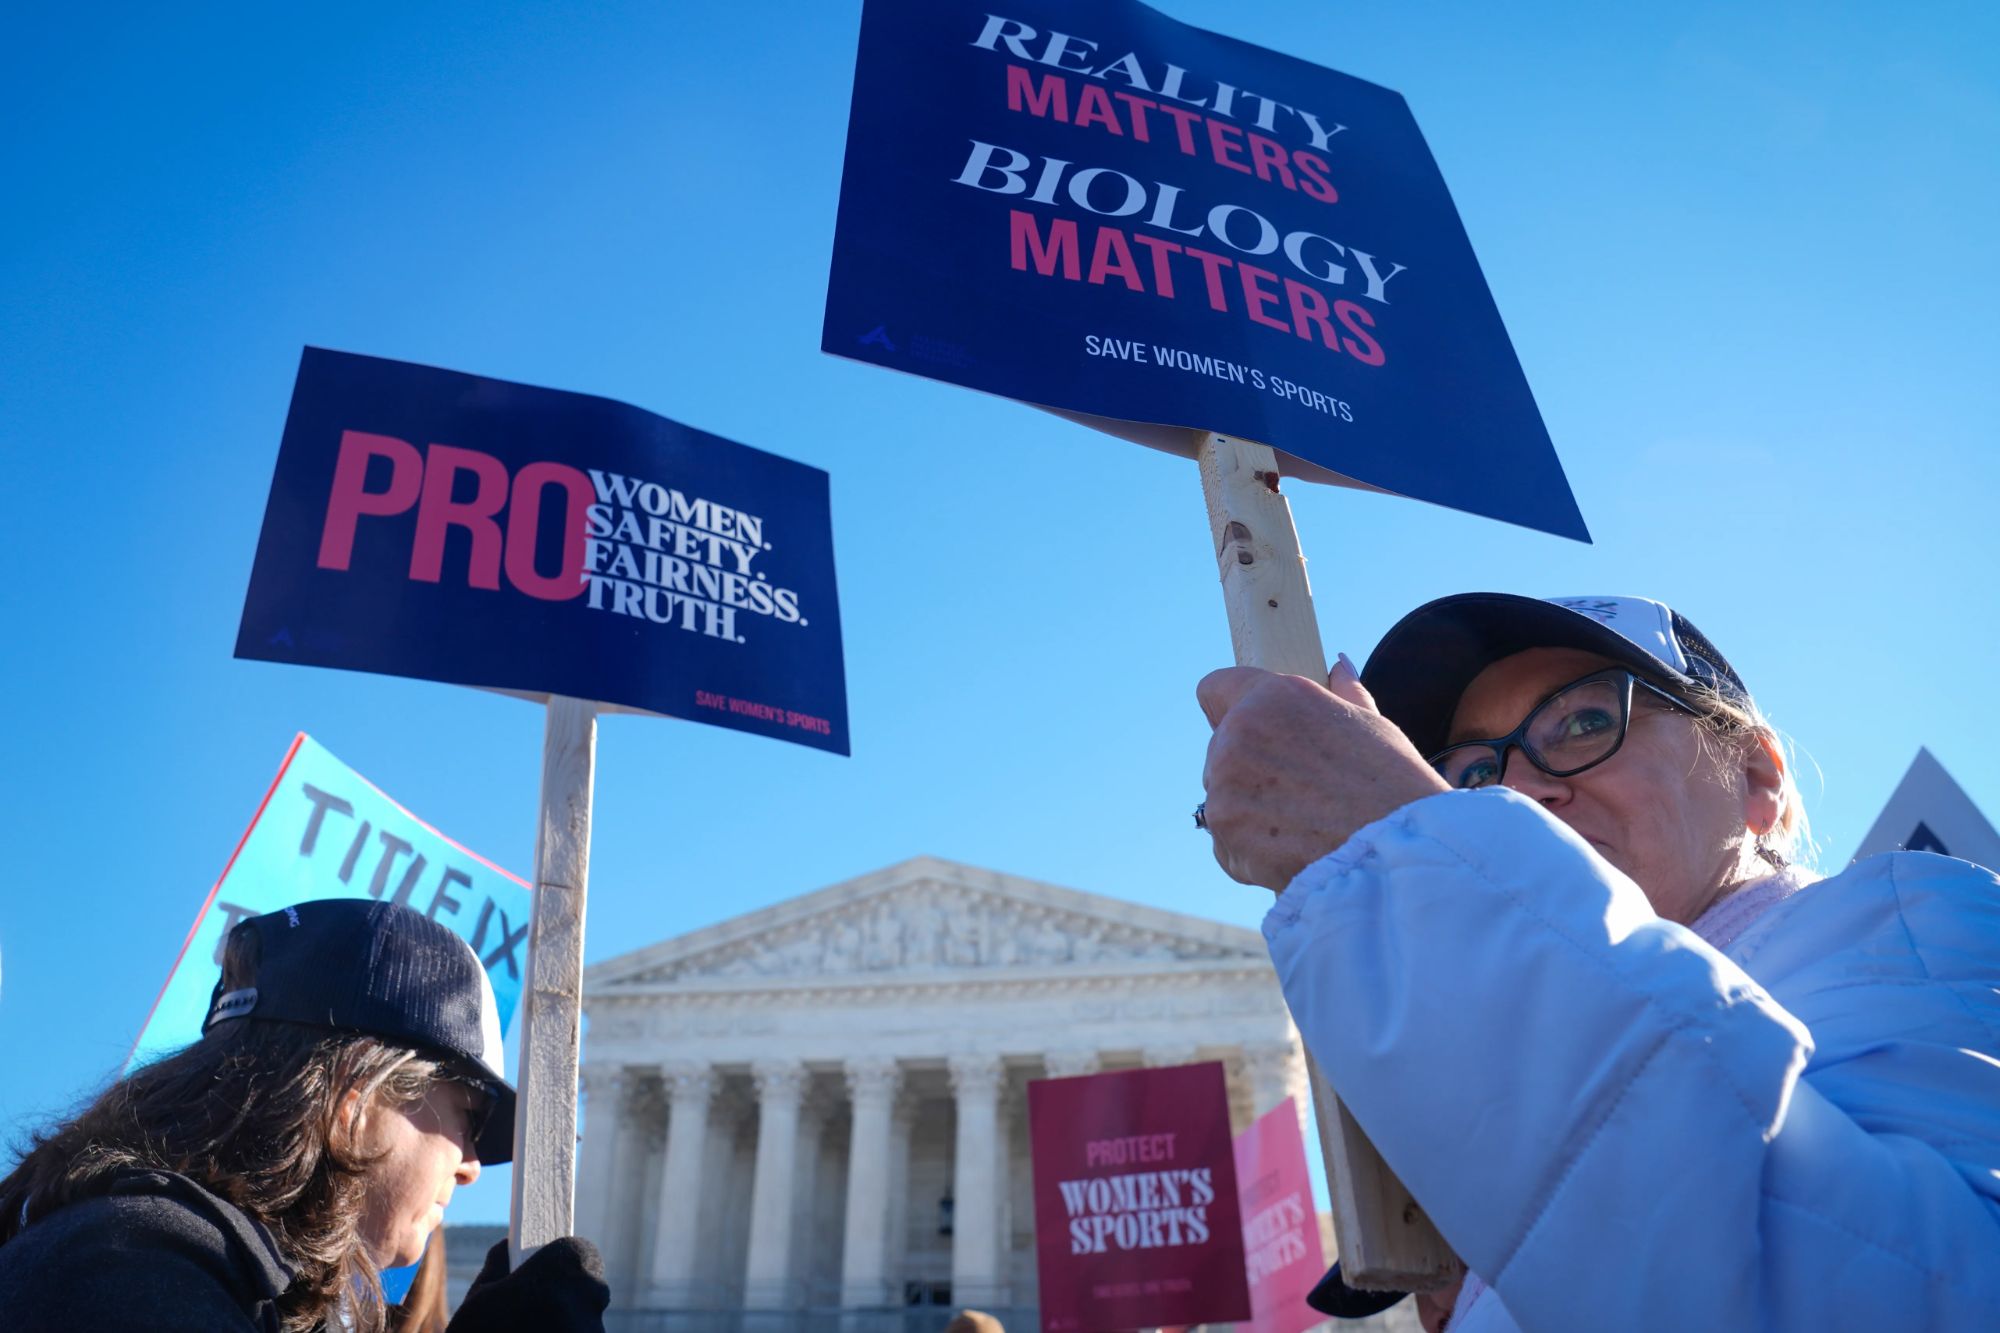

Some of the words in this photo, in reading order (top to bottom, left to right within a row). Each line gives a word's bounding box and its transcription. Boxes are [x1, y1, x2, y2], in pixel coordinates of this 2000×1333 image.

[970, 13, 1348, 153] REALITY
[1006, 65, 1339, 204] MATTERS
[950, 139, 1408, 305] BIOLOGY
[1009, 209, 1386, 368] MATTERS
[1084, 335, 1148, 364] SAVE
[1152, 345, 1266, 390] WOMEN'S
[1269, 376, 1354, 423] SPORTS
[316, 429, 596, 601] PRO
[584, 503, 766, 581] SAFETY.
[587, 468, 772, 552] WOMEN.
[580, 572, 746, 645] TRUTH.
[582, 536, 809, 627] FAIRNESS.
[695, 689, 727, 711] SAVE
[786, 709, 831, 735] SPORTS
[465, 894, 530, 982] IX
[1058, 1167, 1215, 1219] WOMEN'S
[1086, 1133, 1177, 1168] PROTECT
[1068, 1206, 1210, 1256] SPORTS
